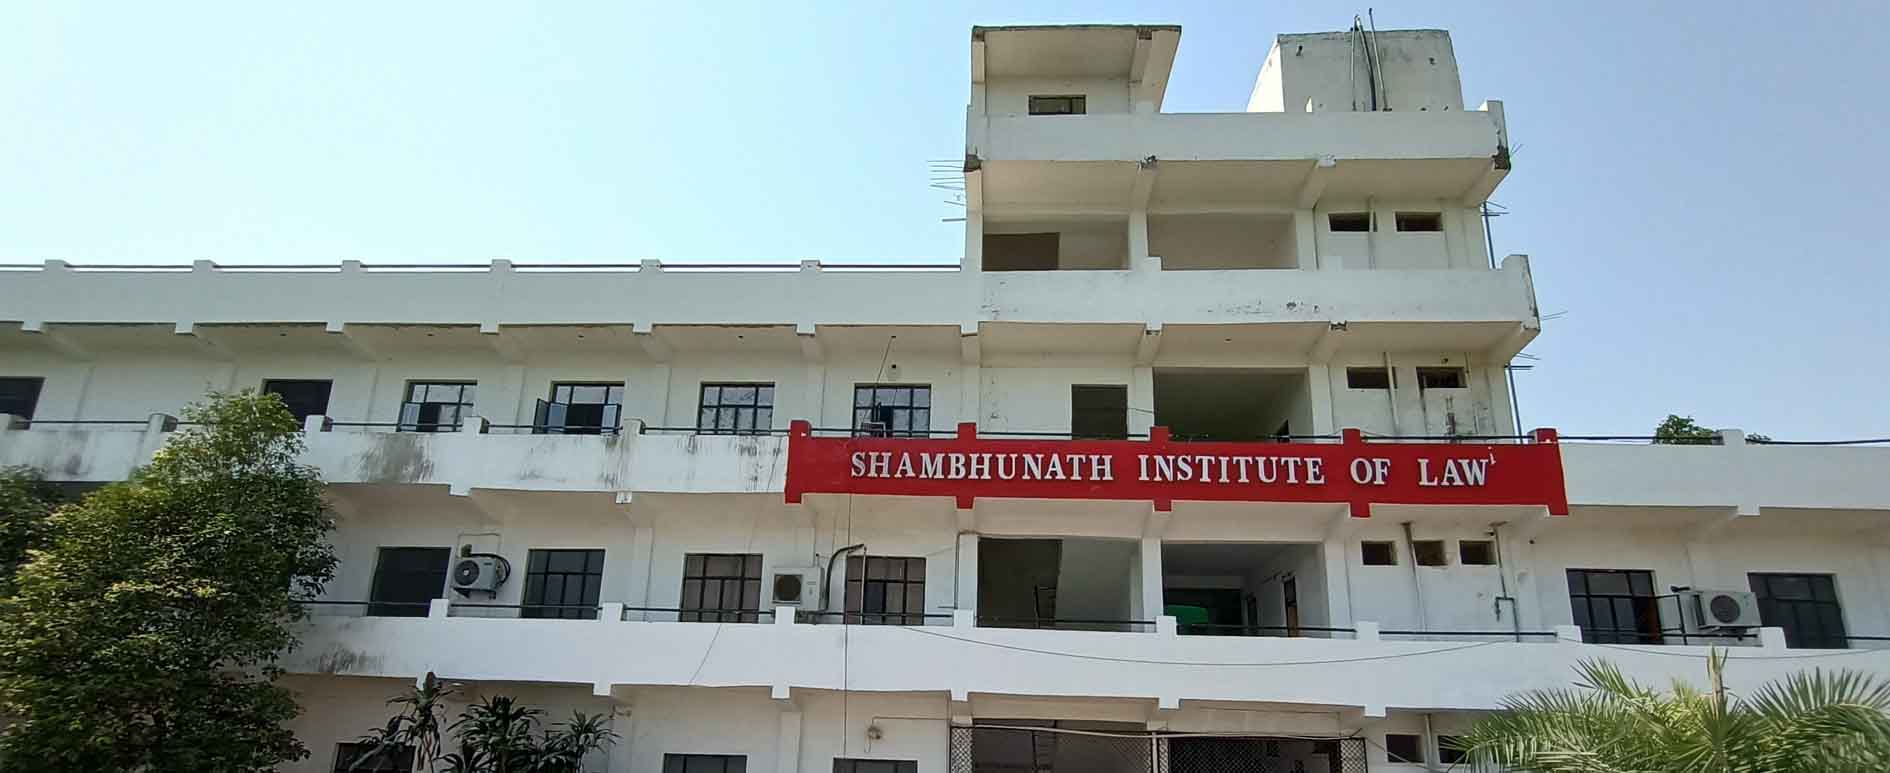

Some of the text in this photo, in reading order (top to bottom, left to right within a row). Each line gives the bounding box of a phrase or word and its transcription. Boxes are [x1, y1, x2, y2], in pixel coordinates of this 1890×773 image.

[850, 451, 1489, 486] SHAMBHUNATH INSTITUTE OF LAW
